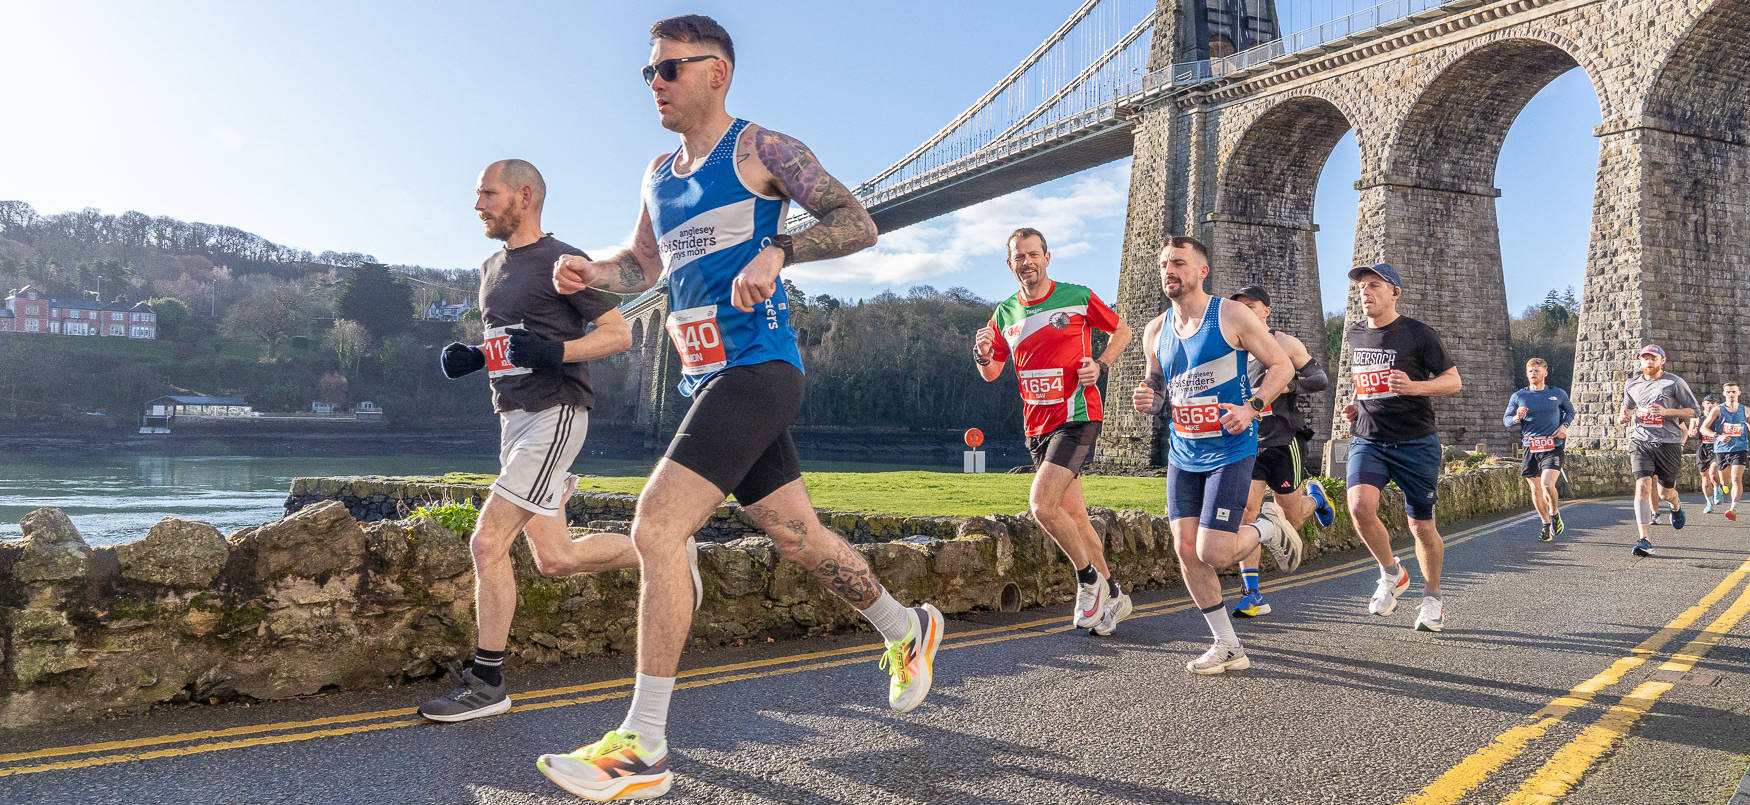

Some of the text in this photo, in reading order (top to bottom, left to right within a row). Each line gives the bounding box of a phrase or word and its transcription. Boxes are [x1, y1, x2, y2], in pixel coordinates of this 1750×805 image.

[680, 226, 715, 237] anglesey
[1021, 377, 1064, 393] 1654
[1353, 371, 1389, 388] 1805
[1172, 406, 1218, 424] 1563
[1530, 439, 1553, 448] 1800
